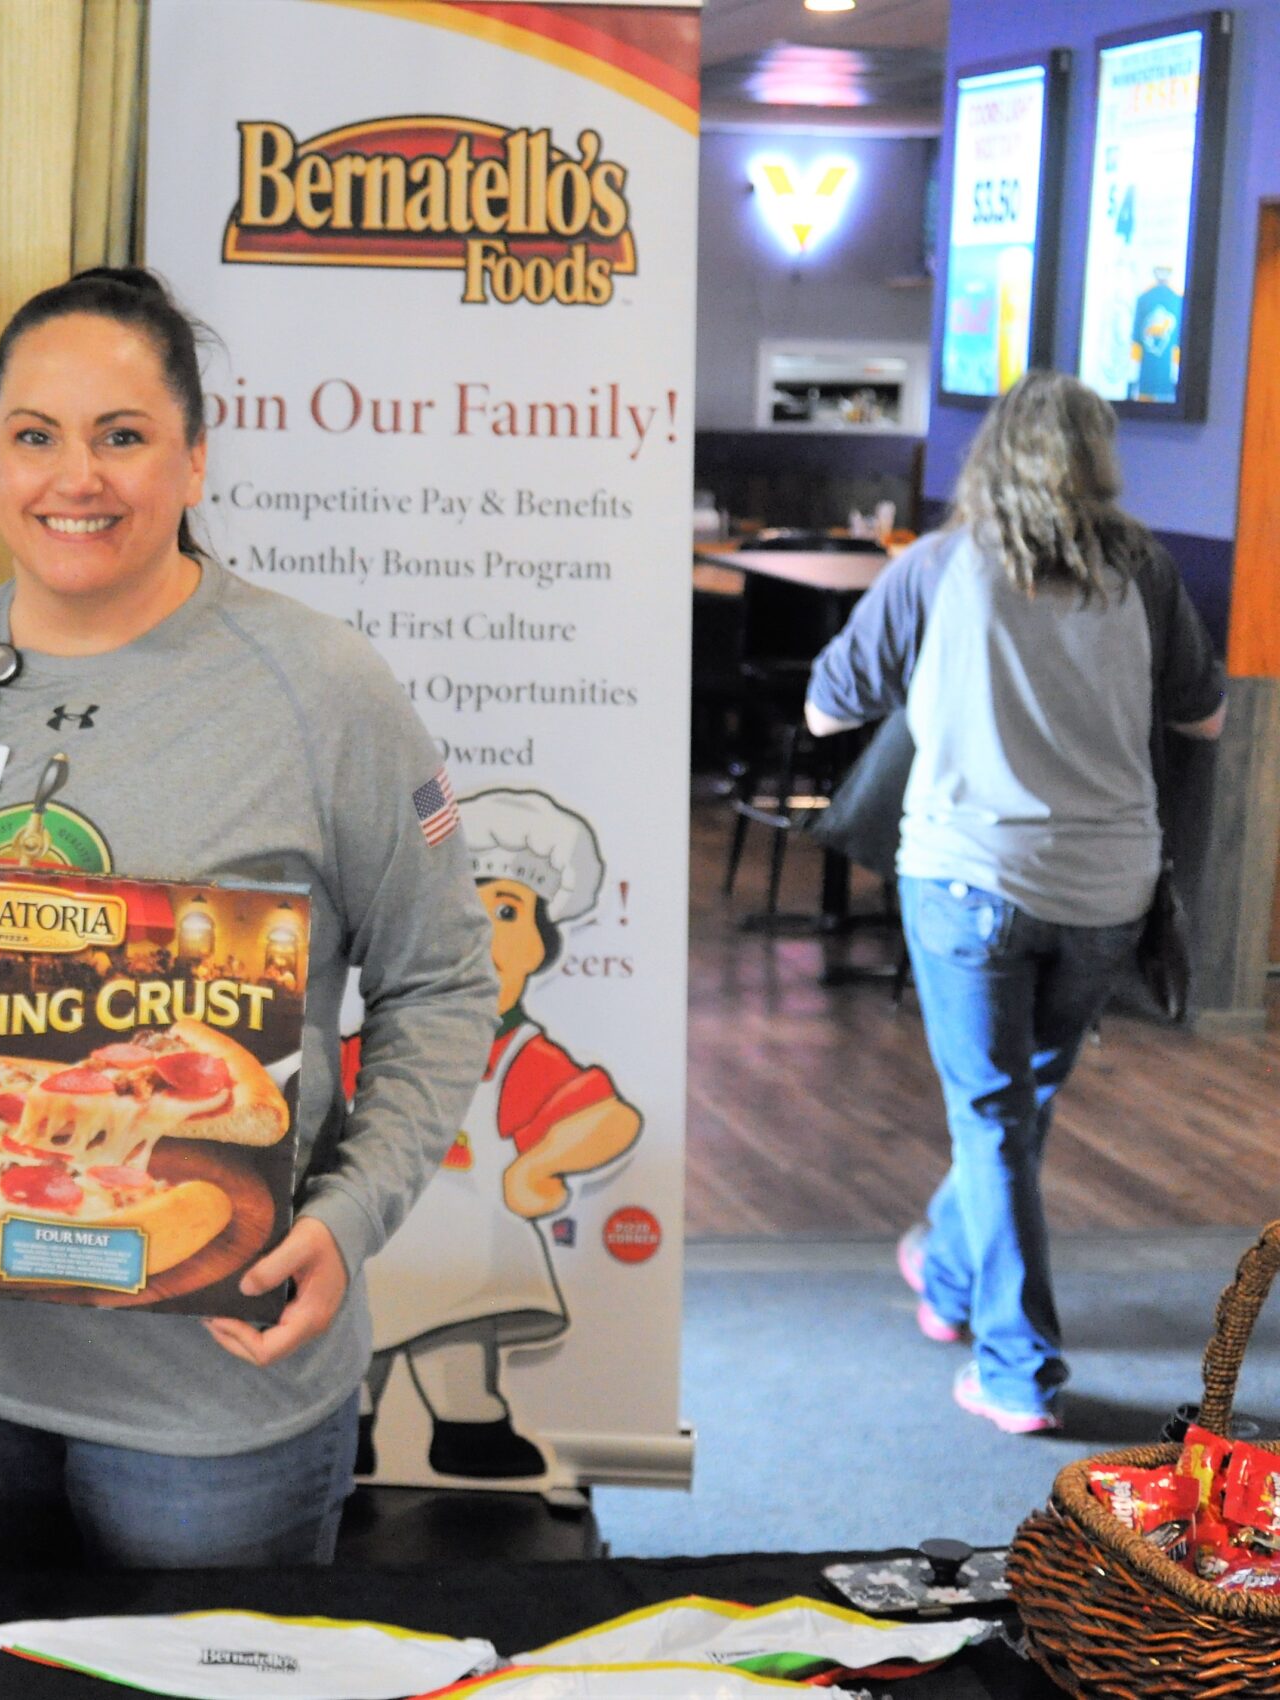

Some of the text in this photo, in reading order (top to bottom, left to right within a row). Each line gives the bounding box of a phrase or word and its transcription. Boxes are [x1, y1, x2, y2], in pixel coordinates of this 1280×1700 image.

[237, 121, 629, 238] Bernatello's
[461, 238, 614, 306] Foods
[203, 377, 679, 460] oin Our Family!
[230, 481, 633, 524] Competitive Pay & Benefits
[247, 545, 612, 588] Monthly Bonus Program
[389, 610, 455, 640] First
[463, 612, 578, 642] Culture
[427, 674, 639, 712] Opportunities
[561, 954, 634, 978] eers
[94, 976, 274, 1032] CRUST
[35, 1228, 111, 1247] FOUR MEAT
